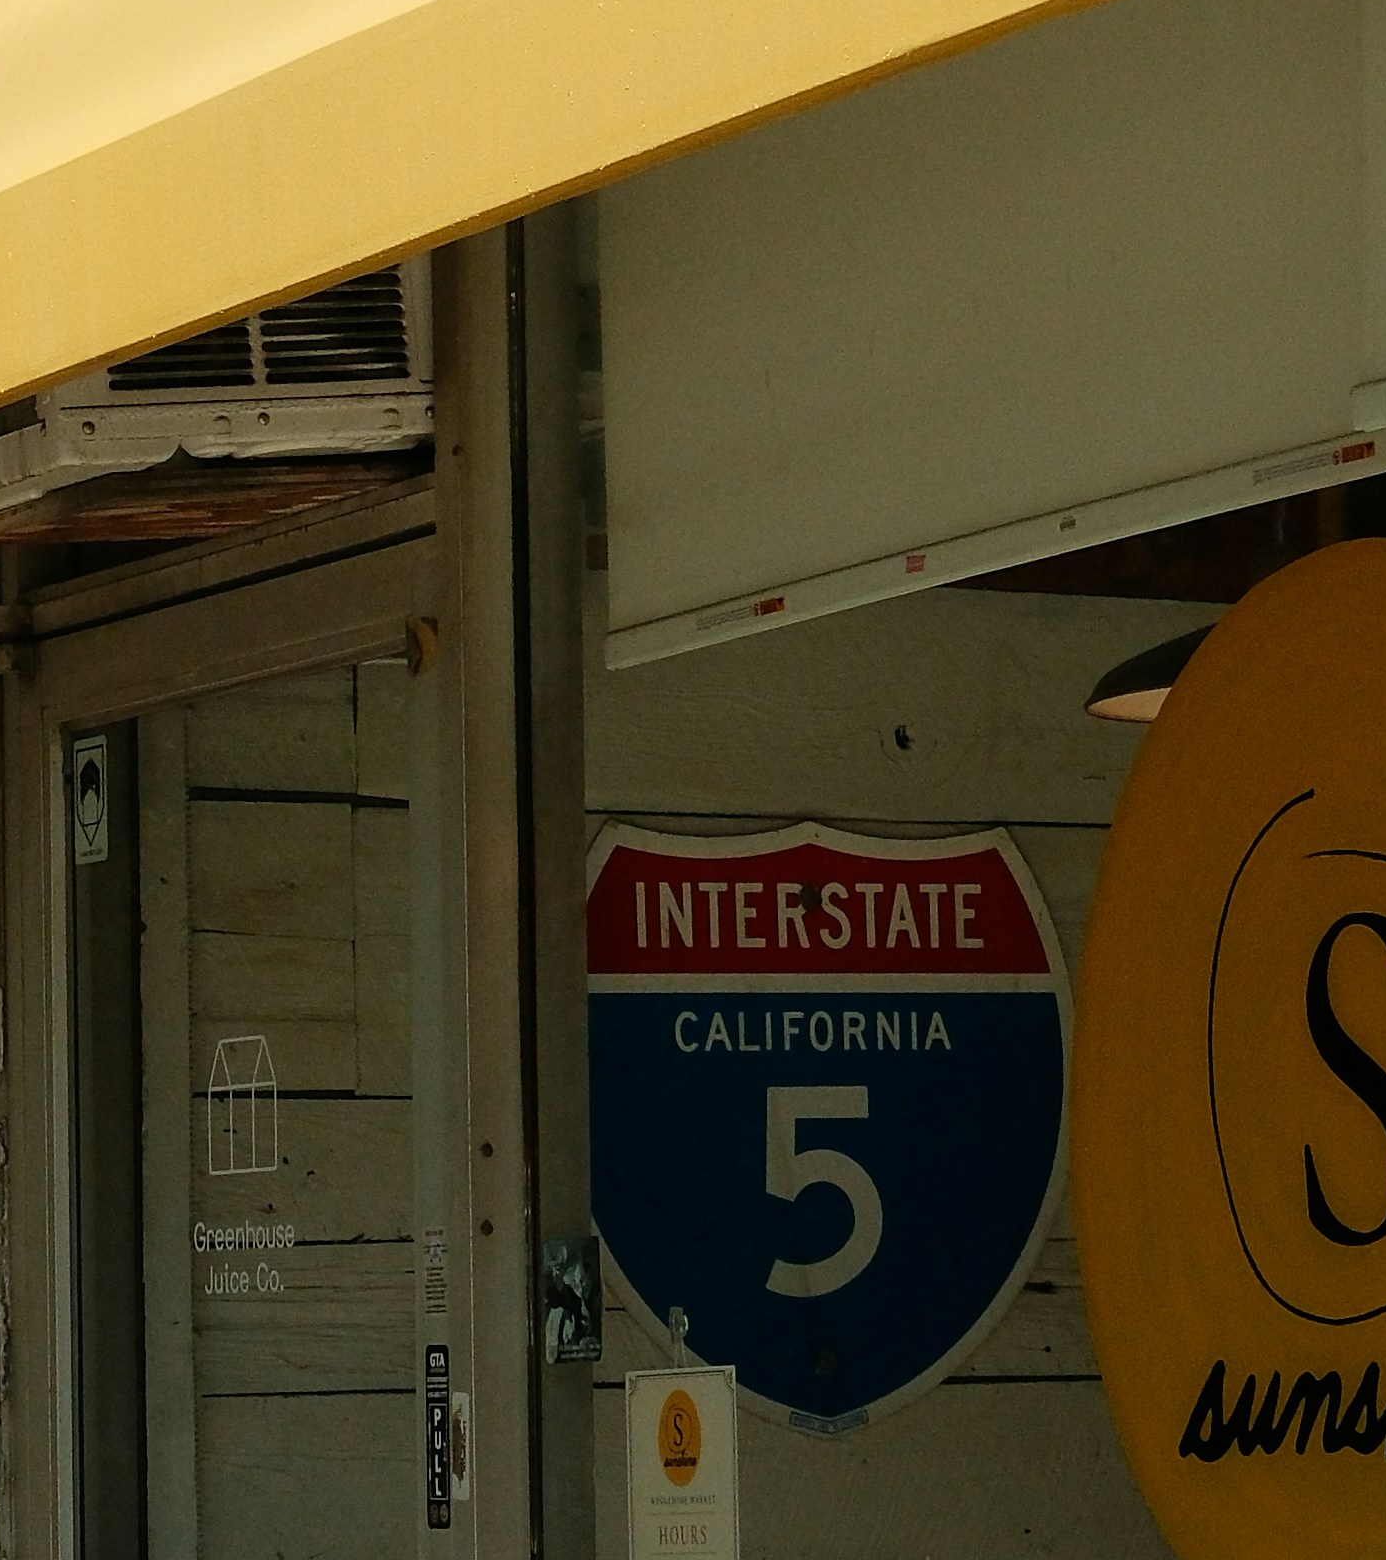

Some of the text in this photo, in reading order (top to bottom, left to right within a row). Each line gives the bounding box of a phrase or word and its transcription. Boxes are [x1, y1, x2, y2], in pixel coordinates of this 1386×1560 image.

[633, 880, 986, 951] INTERSTATE
[673, 1009, 952, 1053] CALIFORNIA
[763, 1085, 884, 1299] 5
[192, 1218, 295, 1254] Greenhouse
[203, 1260, 285, 1296] Juice Co.
[430, 1352, 445, 1368] GTA
[432, 1407, 444, 1497] PULL
[658, 1525, 708, 1545] HOURS
